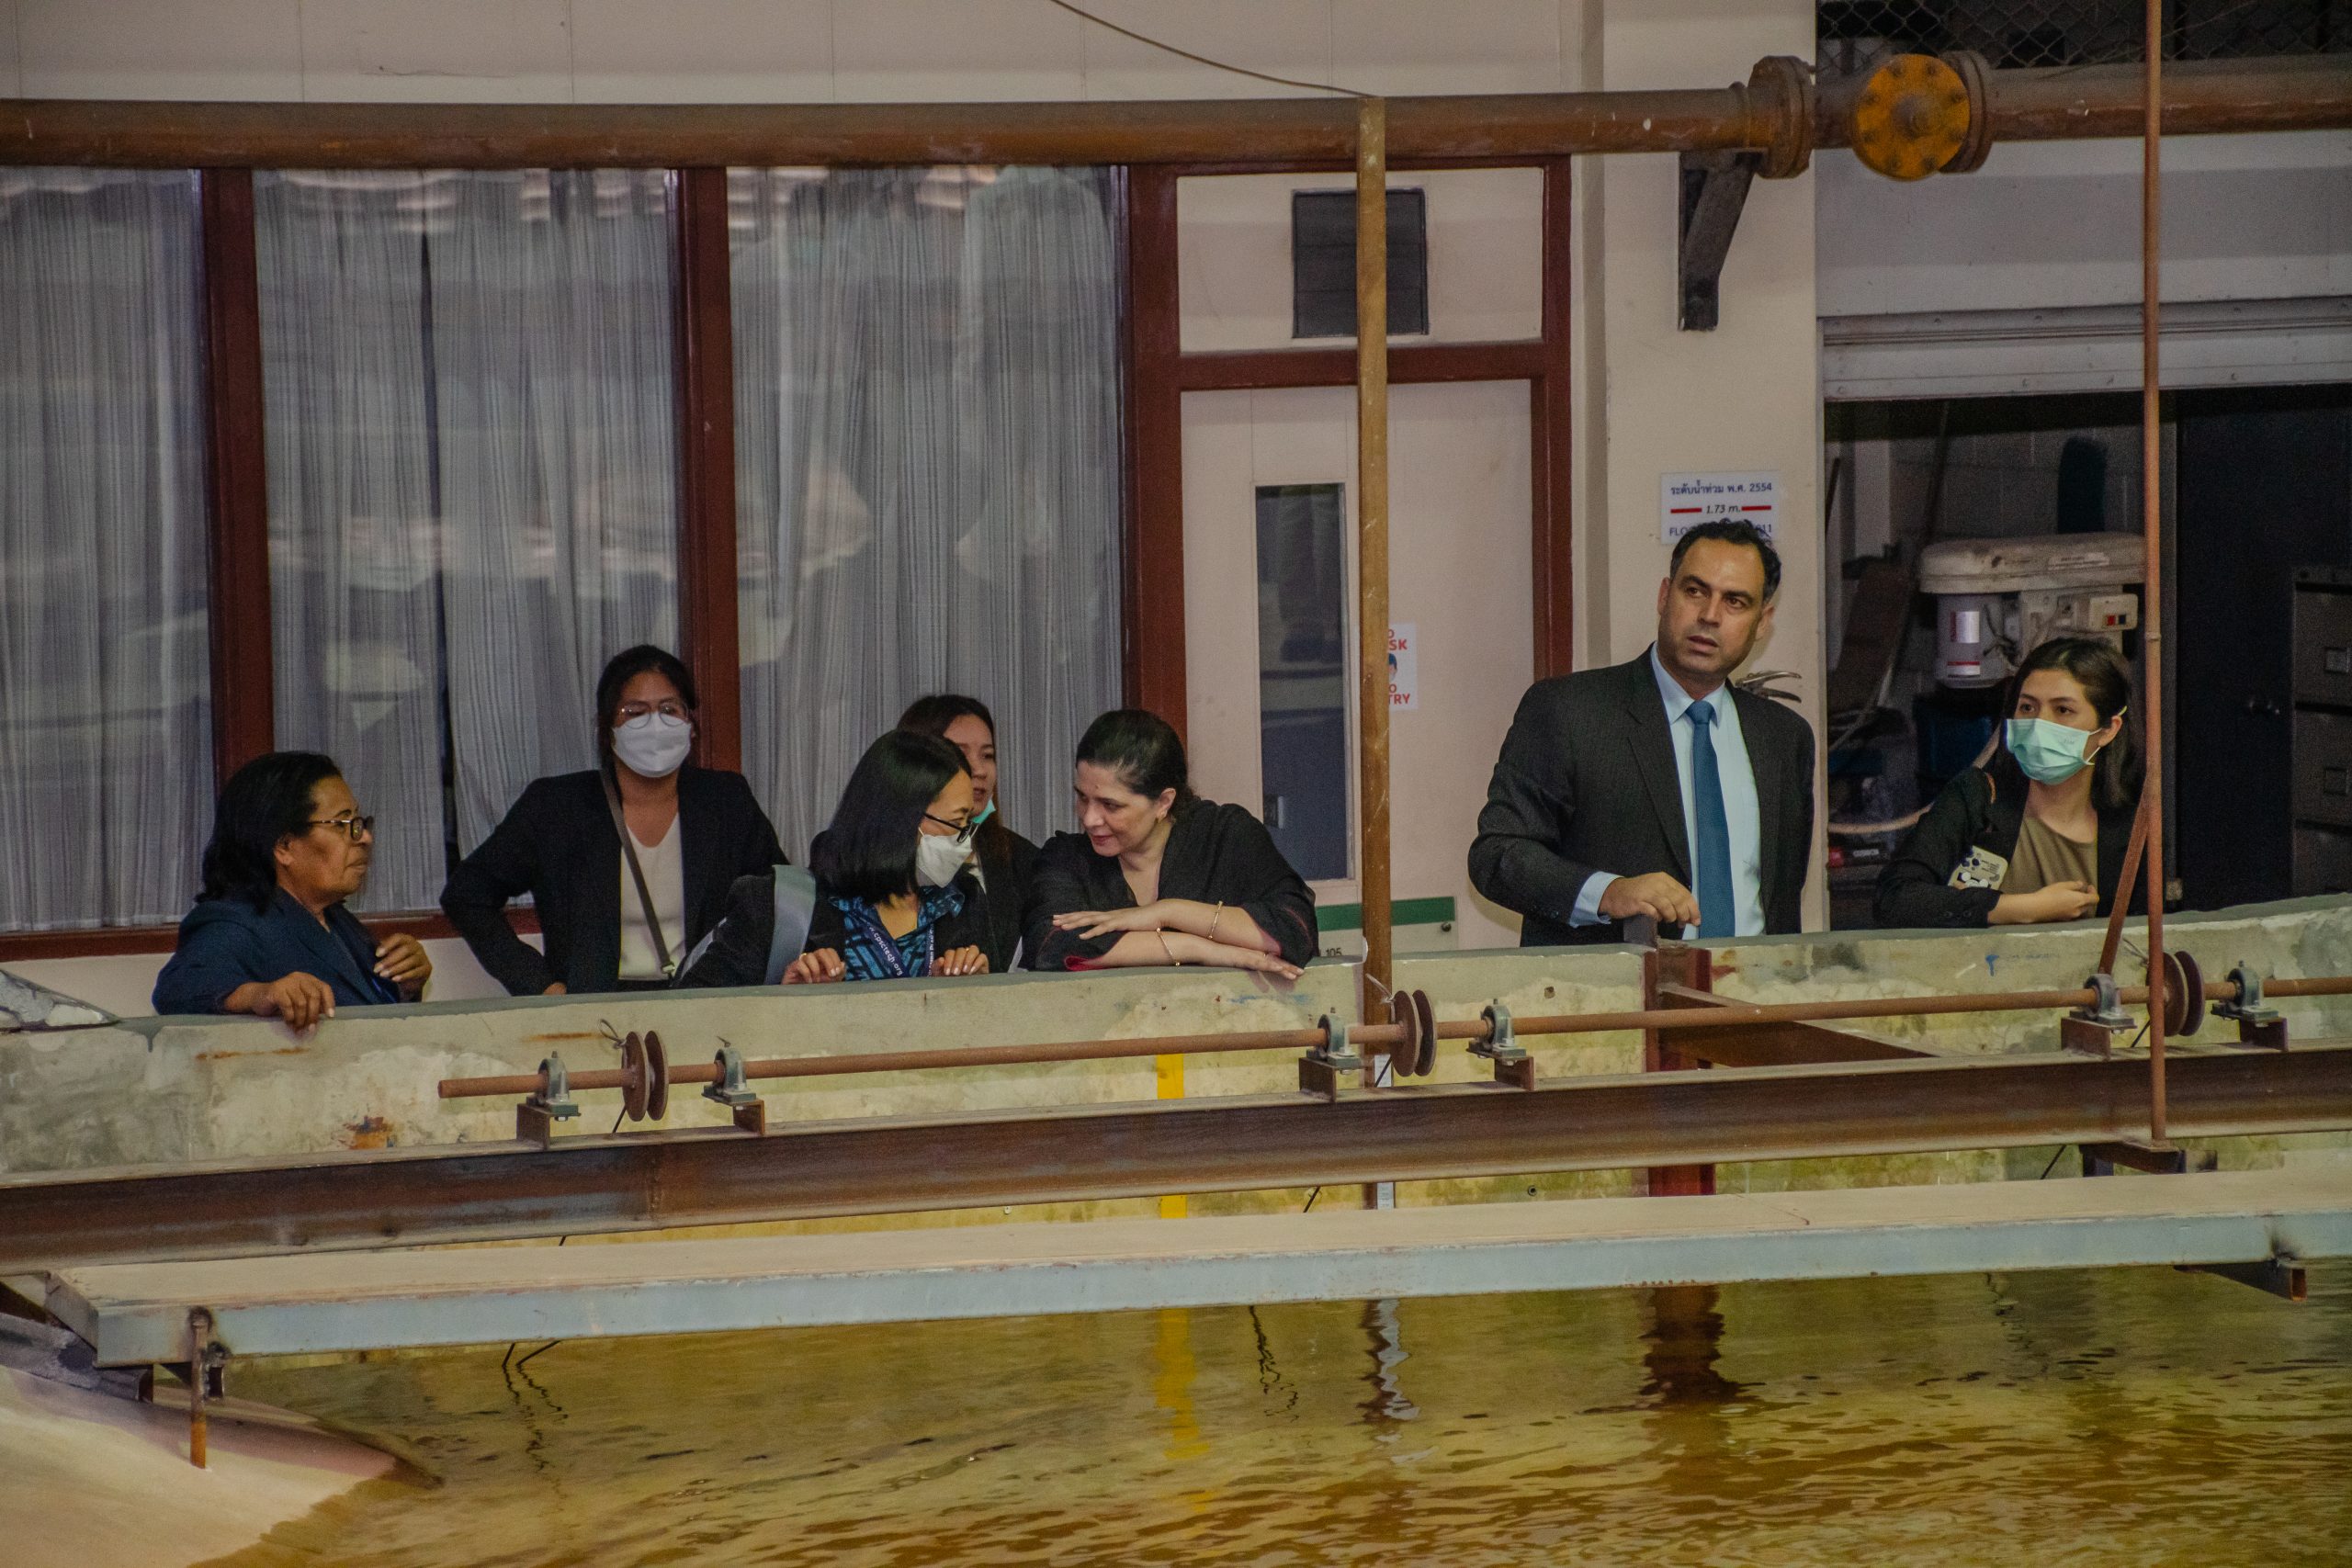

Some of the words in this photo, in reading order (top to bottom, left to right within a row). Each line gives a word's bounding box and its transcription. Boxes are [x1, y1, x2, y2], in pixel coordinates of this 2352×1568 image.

[1670, 479, 1724, 495] ระดับน้ำท่วม
[1727, 483, 1746, 493] พ.ศ.
[1749, 482, 1772, 492] 2554
[1706, 504, 1725, 514] 1.73
[1669, 526, 1688, 536] FLO
[1387, 629, 1395, 638] O
[1389, 639, 1408, 650] SK
[1388, 684, 1396, 693] O
[1387, 694, 1410, 705] TRY
[1326, 947, 1342, 956] 105
